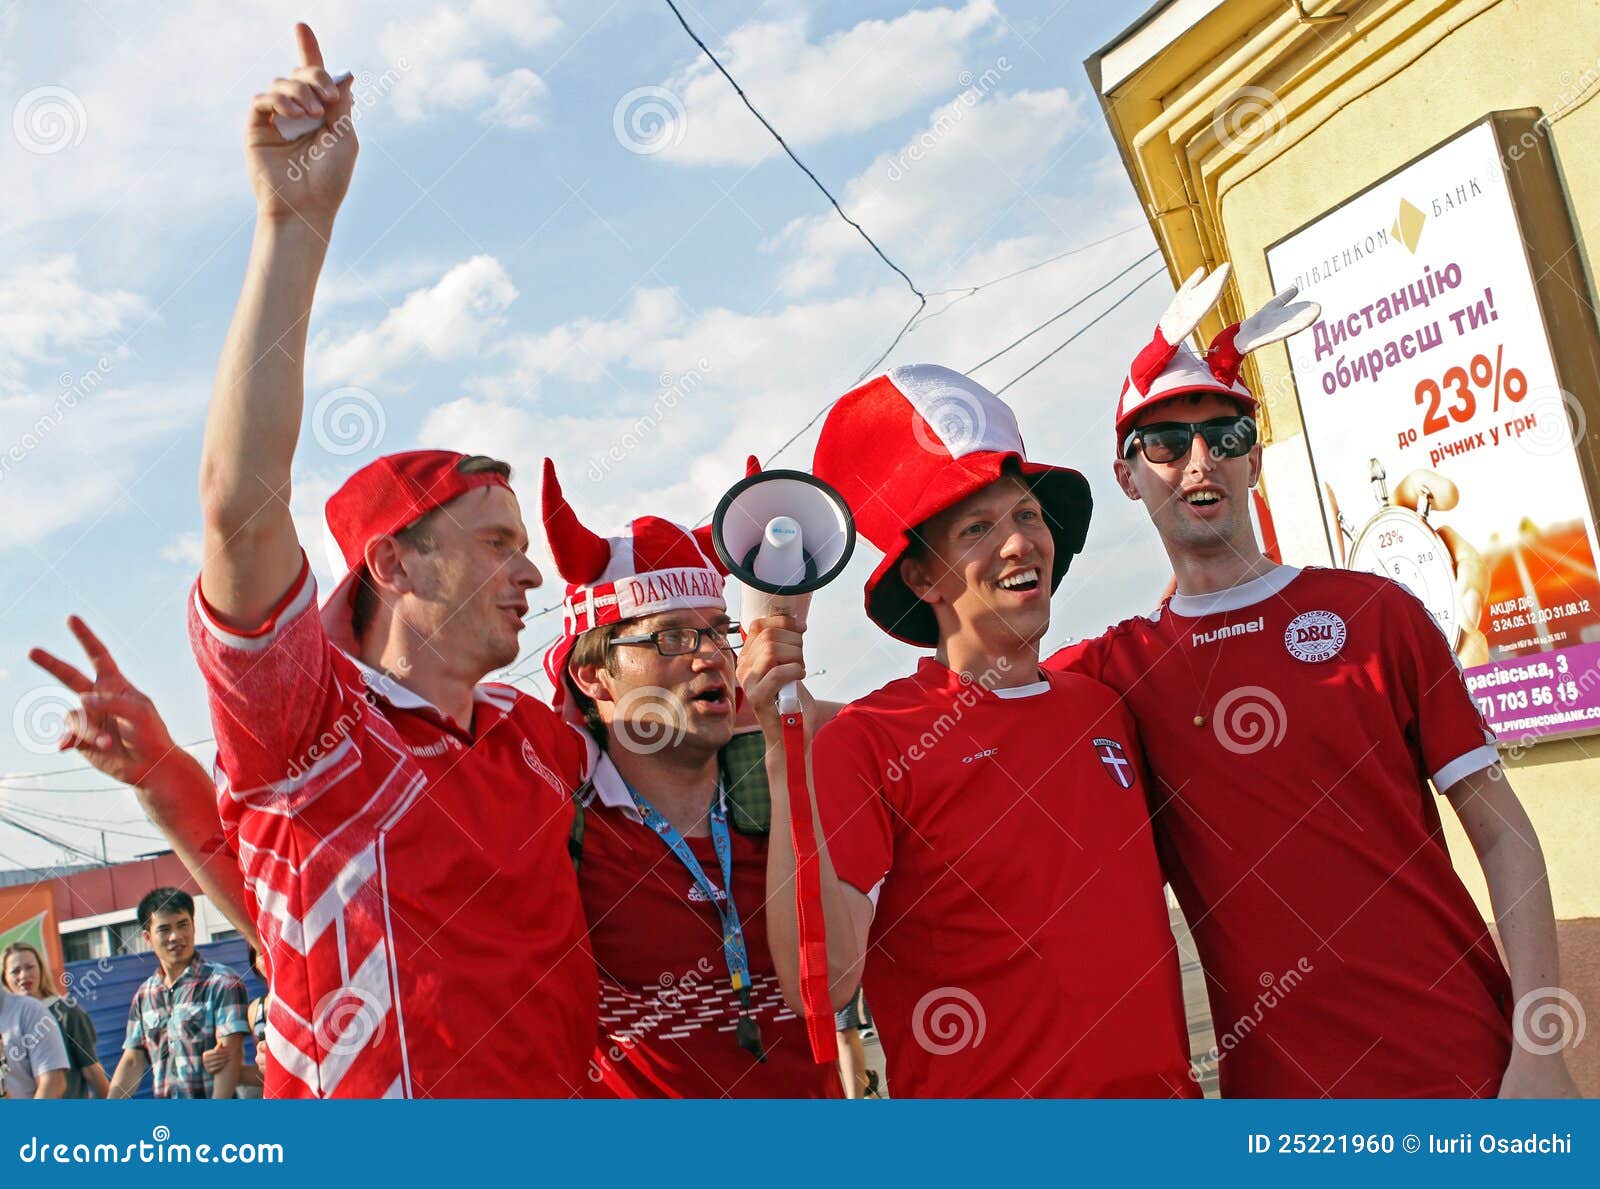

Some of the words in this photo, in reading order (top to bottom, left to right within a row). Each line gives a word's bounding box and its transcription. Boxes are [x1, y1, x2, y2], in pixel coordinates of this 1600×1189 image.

[1431, 177, 1482, 218] БАНК
[1312, 262, 1462, 362] Дистанцію
[1322, 321, 1443, 395] обираєш
[1449, 287, 1499, 336] ти!
[1397, 428, 1417, 450] до
[1414, 344, 1528, 436] 23%
[1429, 431, 1486, 468] річних
[1489, 426, 1499, 446] у
[1504, 413, 1537, 438] грн
[1379, 529, 1404, 548] 23%
[629, 570, 720, 607] DANMARK
[1192, 616, 1264, 647] hummel
[1501, 612, 1537, 630] 24.05.12
[1553, 600, 1591, 619] 31.08.12
[1296, 624, 1334, 644] DBU
[1305, 651, 1330, 661] 1889
[1465, 662, 1554, 694] расівська,
[1556, 654, 1569, 674] 3
[1496, 690, 1528, 711] 703
[1531, 686, 1553, 706] 56
[1557, 681, 1579, 703] 15
[688, 889, 727, 901] adias
